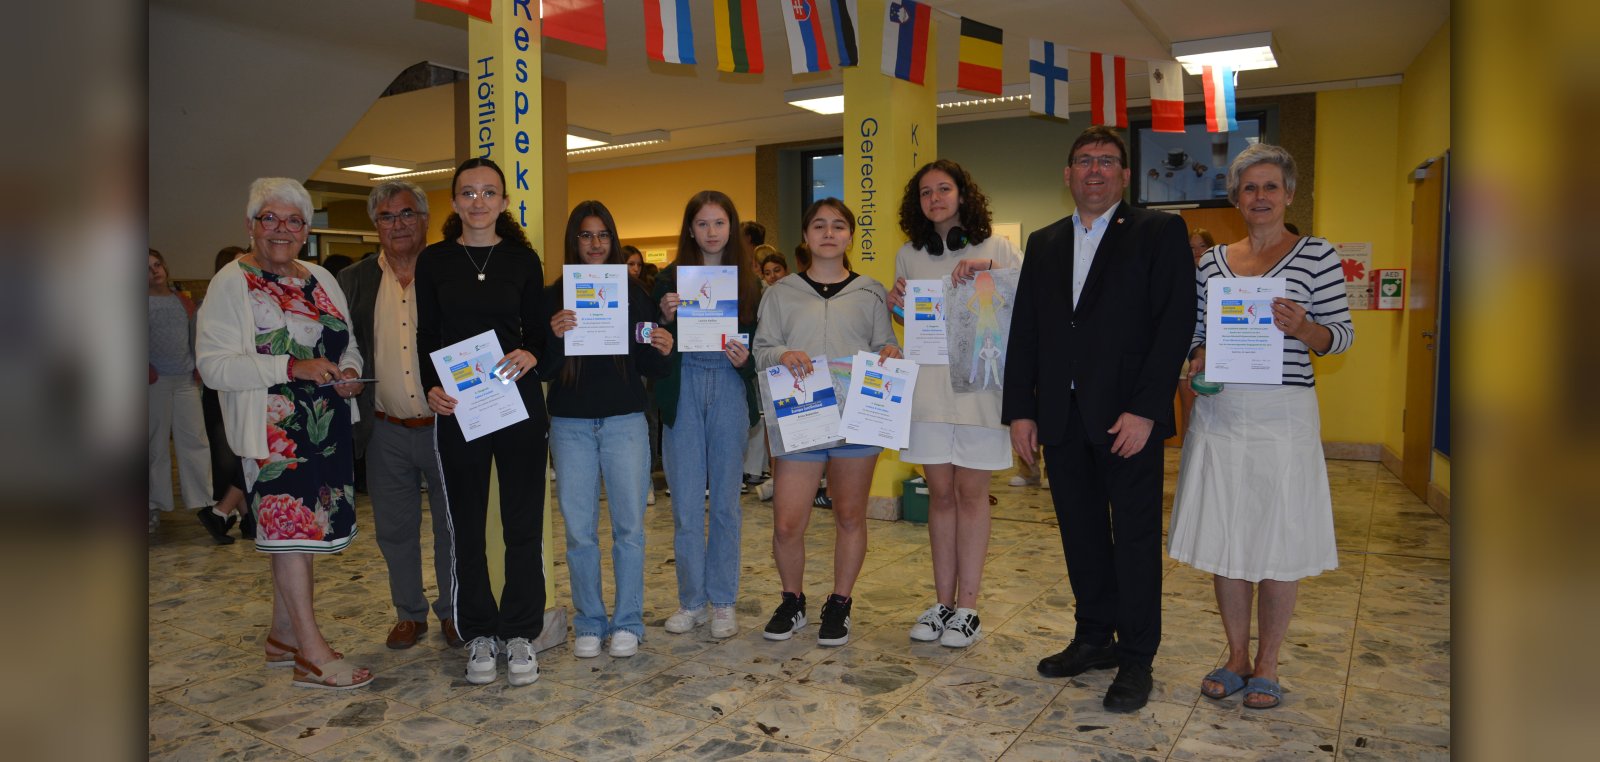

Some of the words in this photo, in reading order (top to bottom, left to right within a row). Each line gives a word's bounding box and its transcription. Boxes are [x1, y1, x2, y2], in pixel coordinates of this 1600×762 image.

[477, 56, 495, 160] Höflich
[513, 0, 532, 228] Respekt
[857, 117, 878, 262] Gerechtigkeit
